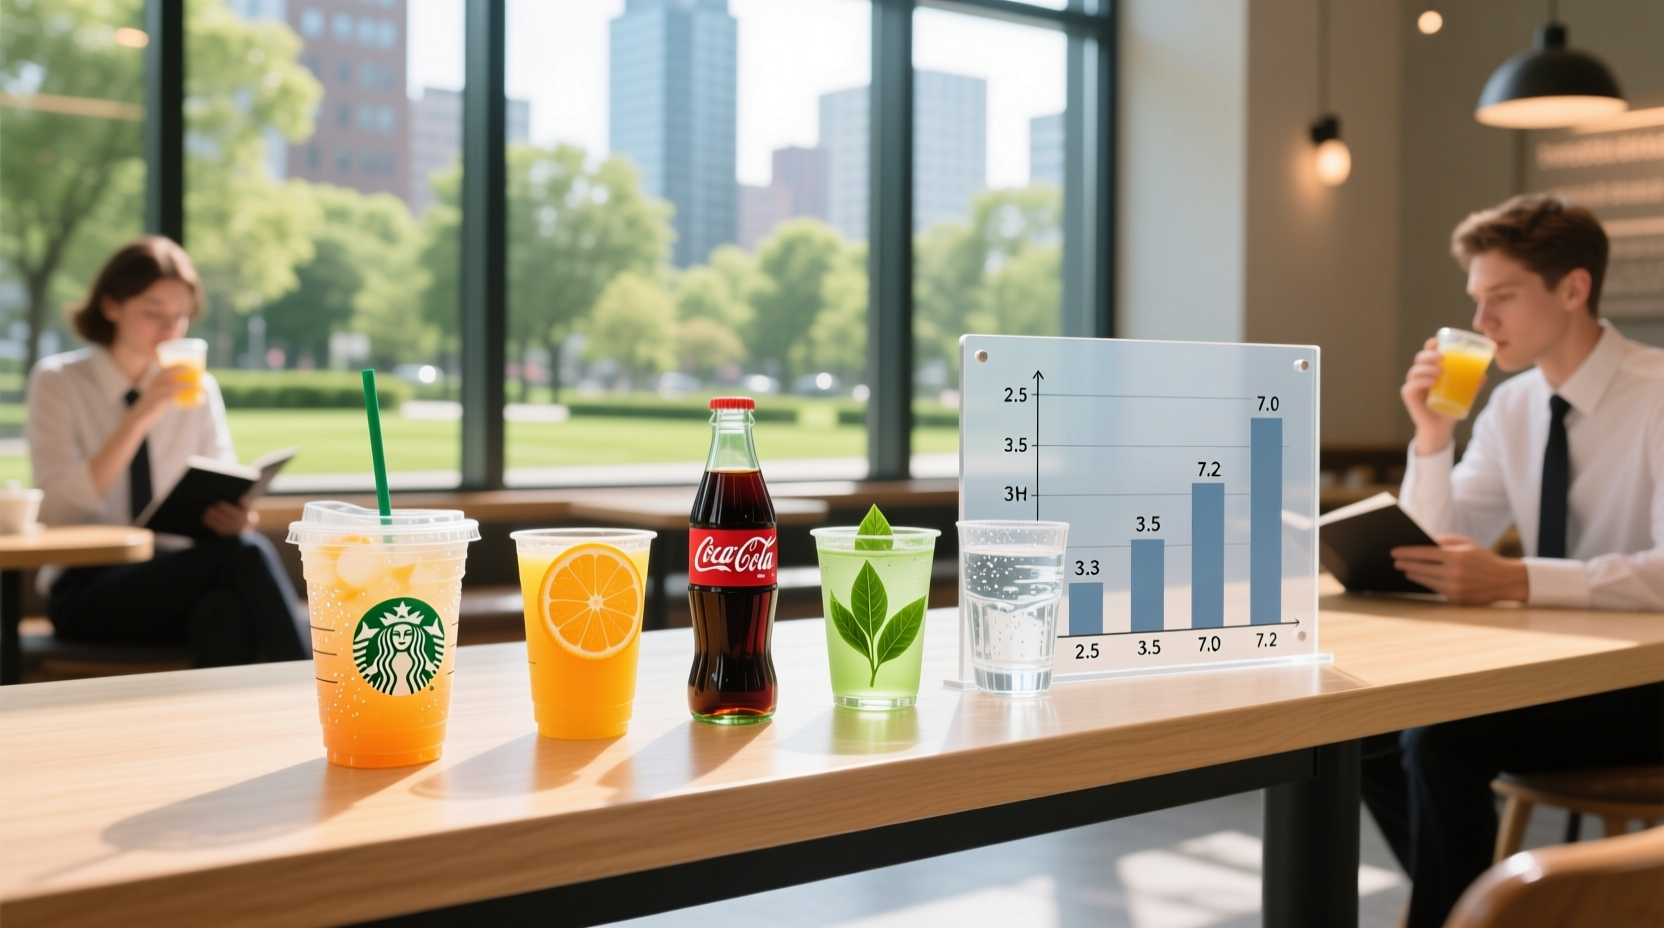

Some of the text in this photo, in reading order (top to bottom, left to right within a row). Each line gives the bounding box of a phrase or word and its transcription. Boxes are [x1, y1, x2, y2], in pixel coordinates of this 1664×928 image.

[1003, 386, 1028, 404] 2.5
[1256, 395, 1280, 412] 7.0
[1003, 437, 1028, 454] 3.5
[1196, 461, 1222, 478] 7.2
[1003, 485, 1028, 502] 3H
[1135, 515, 1162, 533] 3.5
[694, 535, 776, 572] Coca-Cola
[1074, 559, 1101, 576] 3.3
[1074, 632, 1278, 660] 2.5 3.5 7.0 7.2
